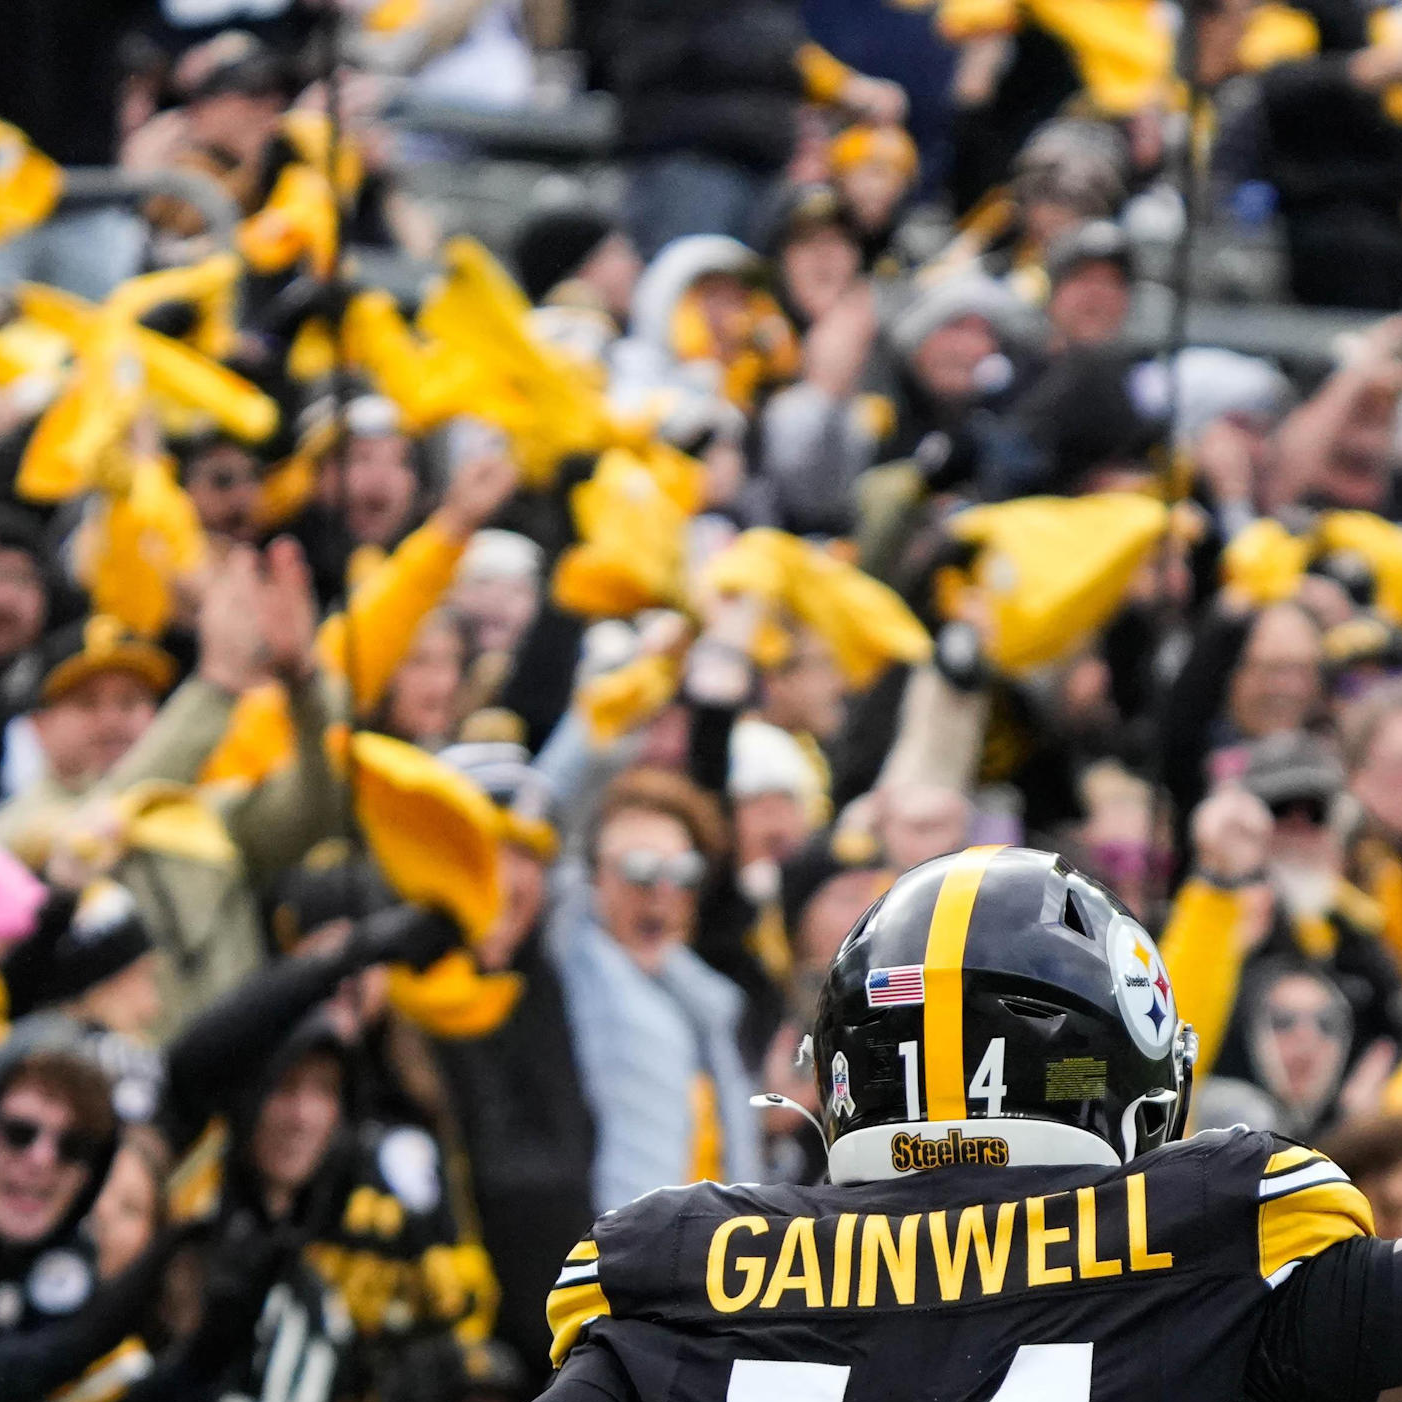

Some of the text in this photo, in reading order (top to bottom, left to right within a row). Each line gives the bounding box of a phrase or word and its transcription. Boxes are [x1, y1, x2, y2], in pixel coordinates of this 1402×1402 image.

[1124, 973, 1151, 988] Steelers
[898, 1036, 1008, 1121] 14
[891, 1128, 1009, 1171] Steelers
[707, 1172, 1174, 1313] GAINWELL
